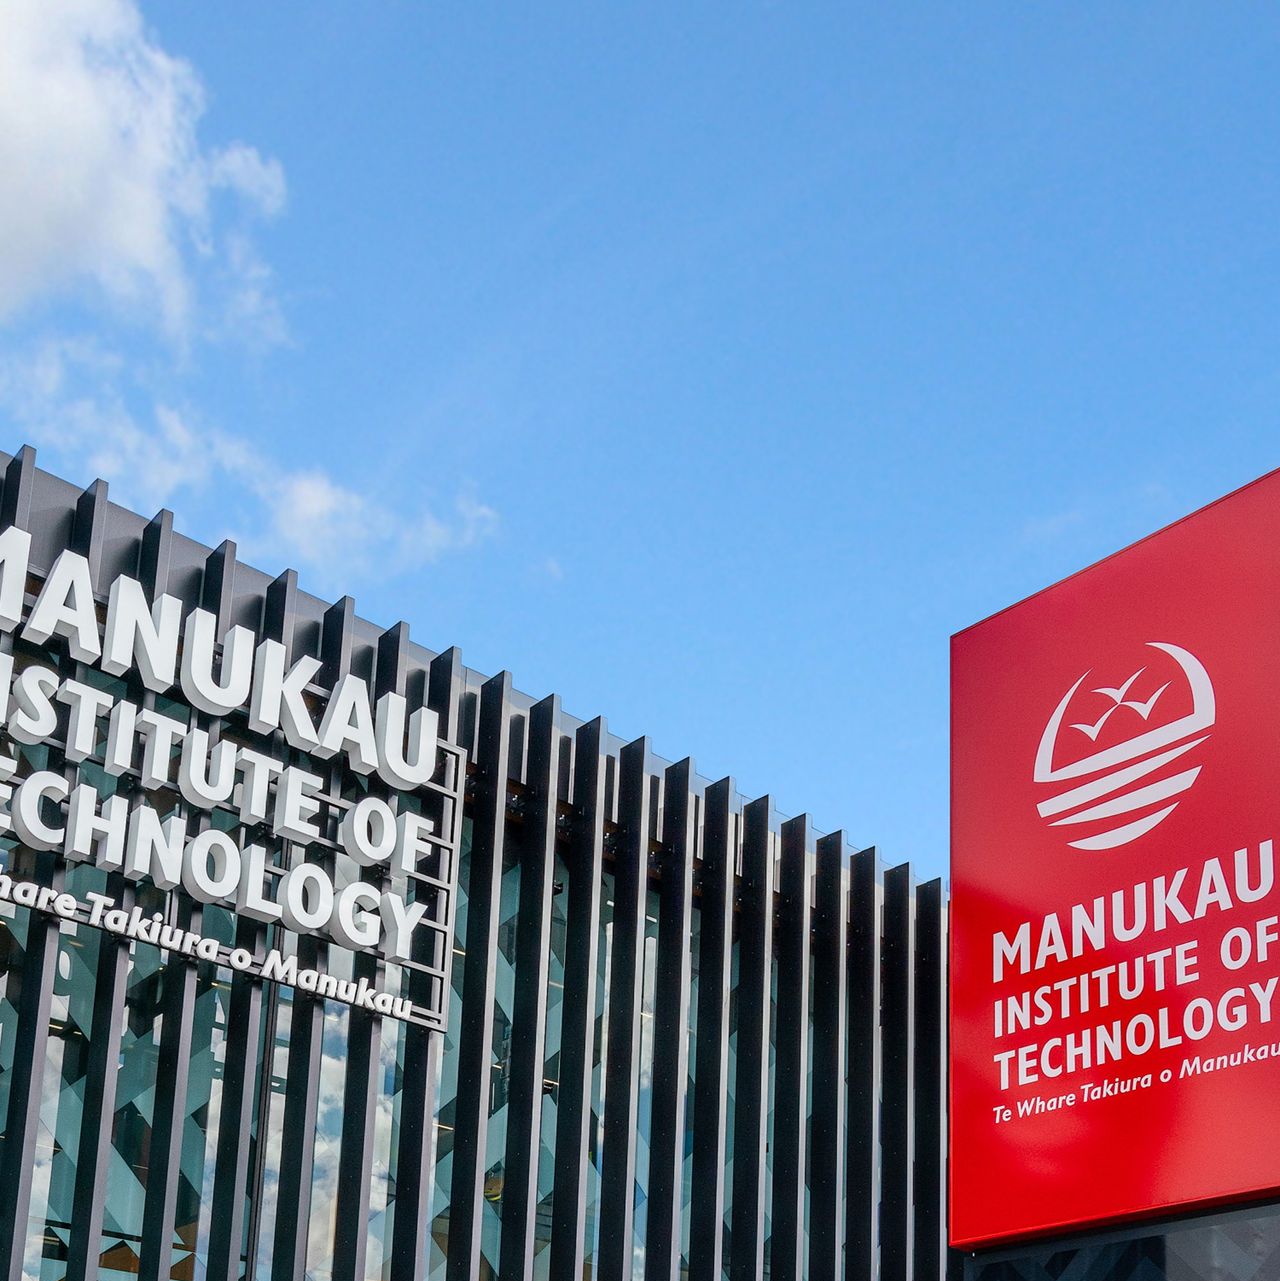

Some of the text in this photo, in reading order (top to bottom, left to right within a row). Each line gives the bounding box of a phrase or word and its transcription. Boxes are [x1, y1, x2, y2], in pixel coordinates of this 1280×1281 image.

[340, 797, 434, 878] OF
[86, 891, 220, 961] Takiura
[229, 948, 252, 970] o
[260, 949, 412, 1020] Manukau
[992, 839, 1275, 983] MANUKAU
[993, 915, 1280, 1039] INSTITUTE OF
[993, 976, 1280, 1091] TECHNOLOGY
[992, 1106, 1012, 1124] Te
[1017, 1092, 1076, 1119] Whare
[1081, 1072, 1153, 1103] Takiura
[1159, 1069, 1172, 1083] o
